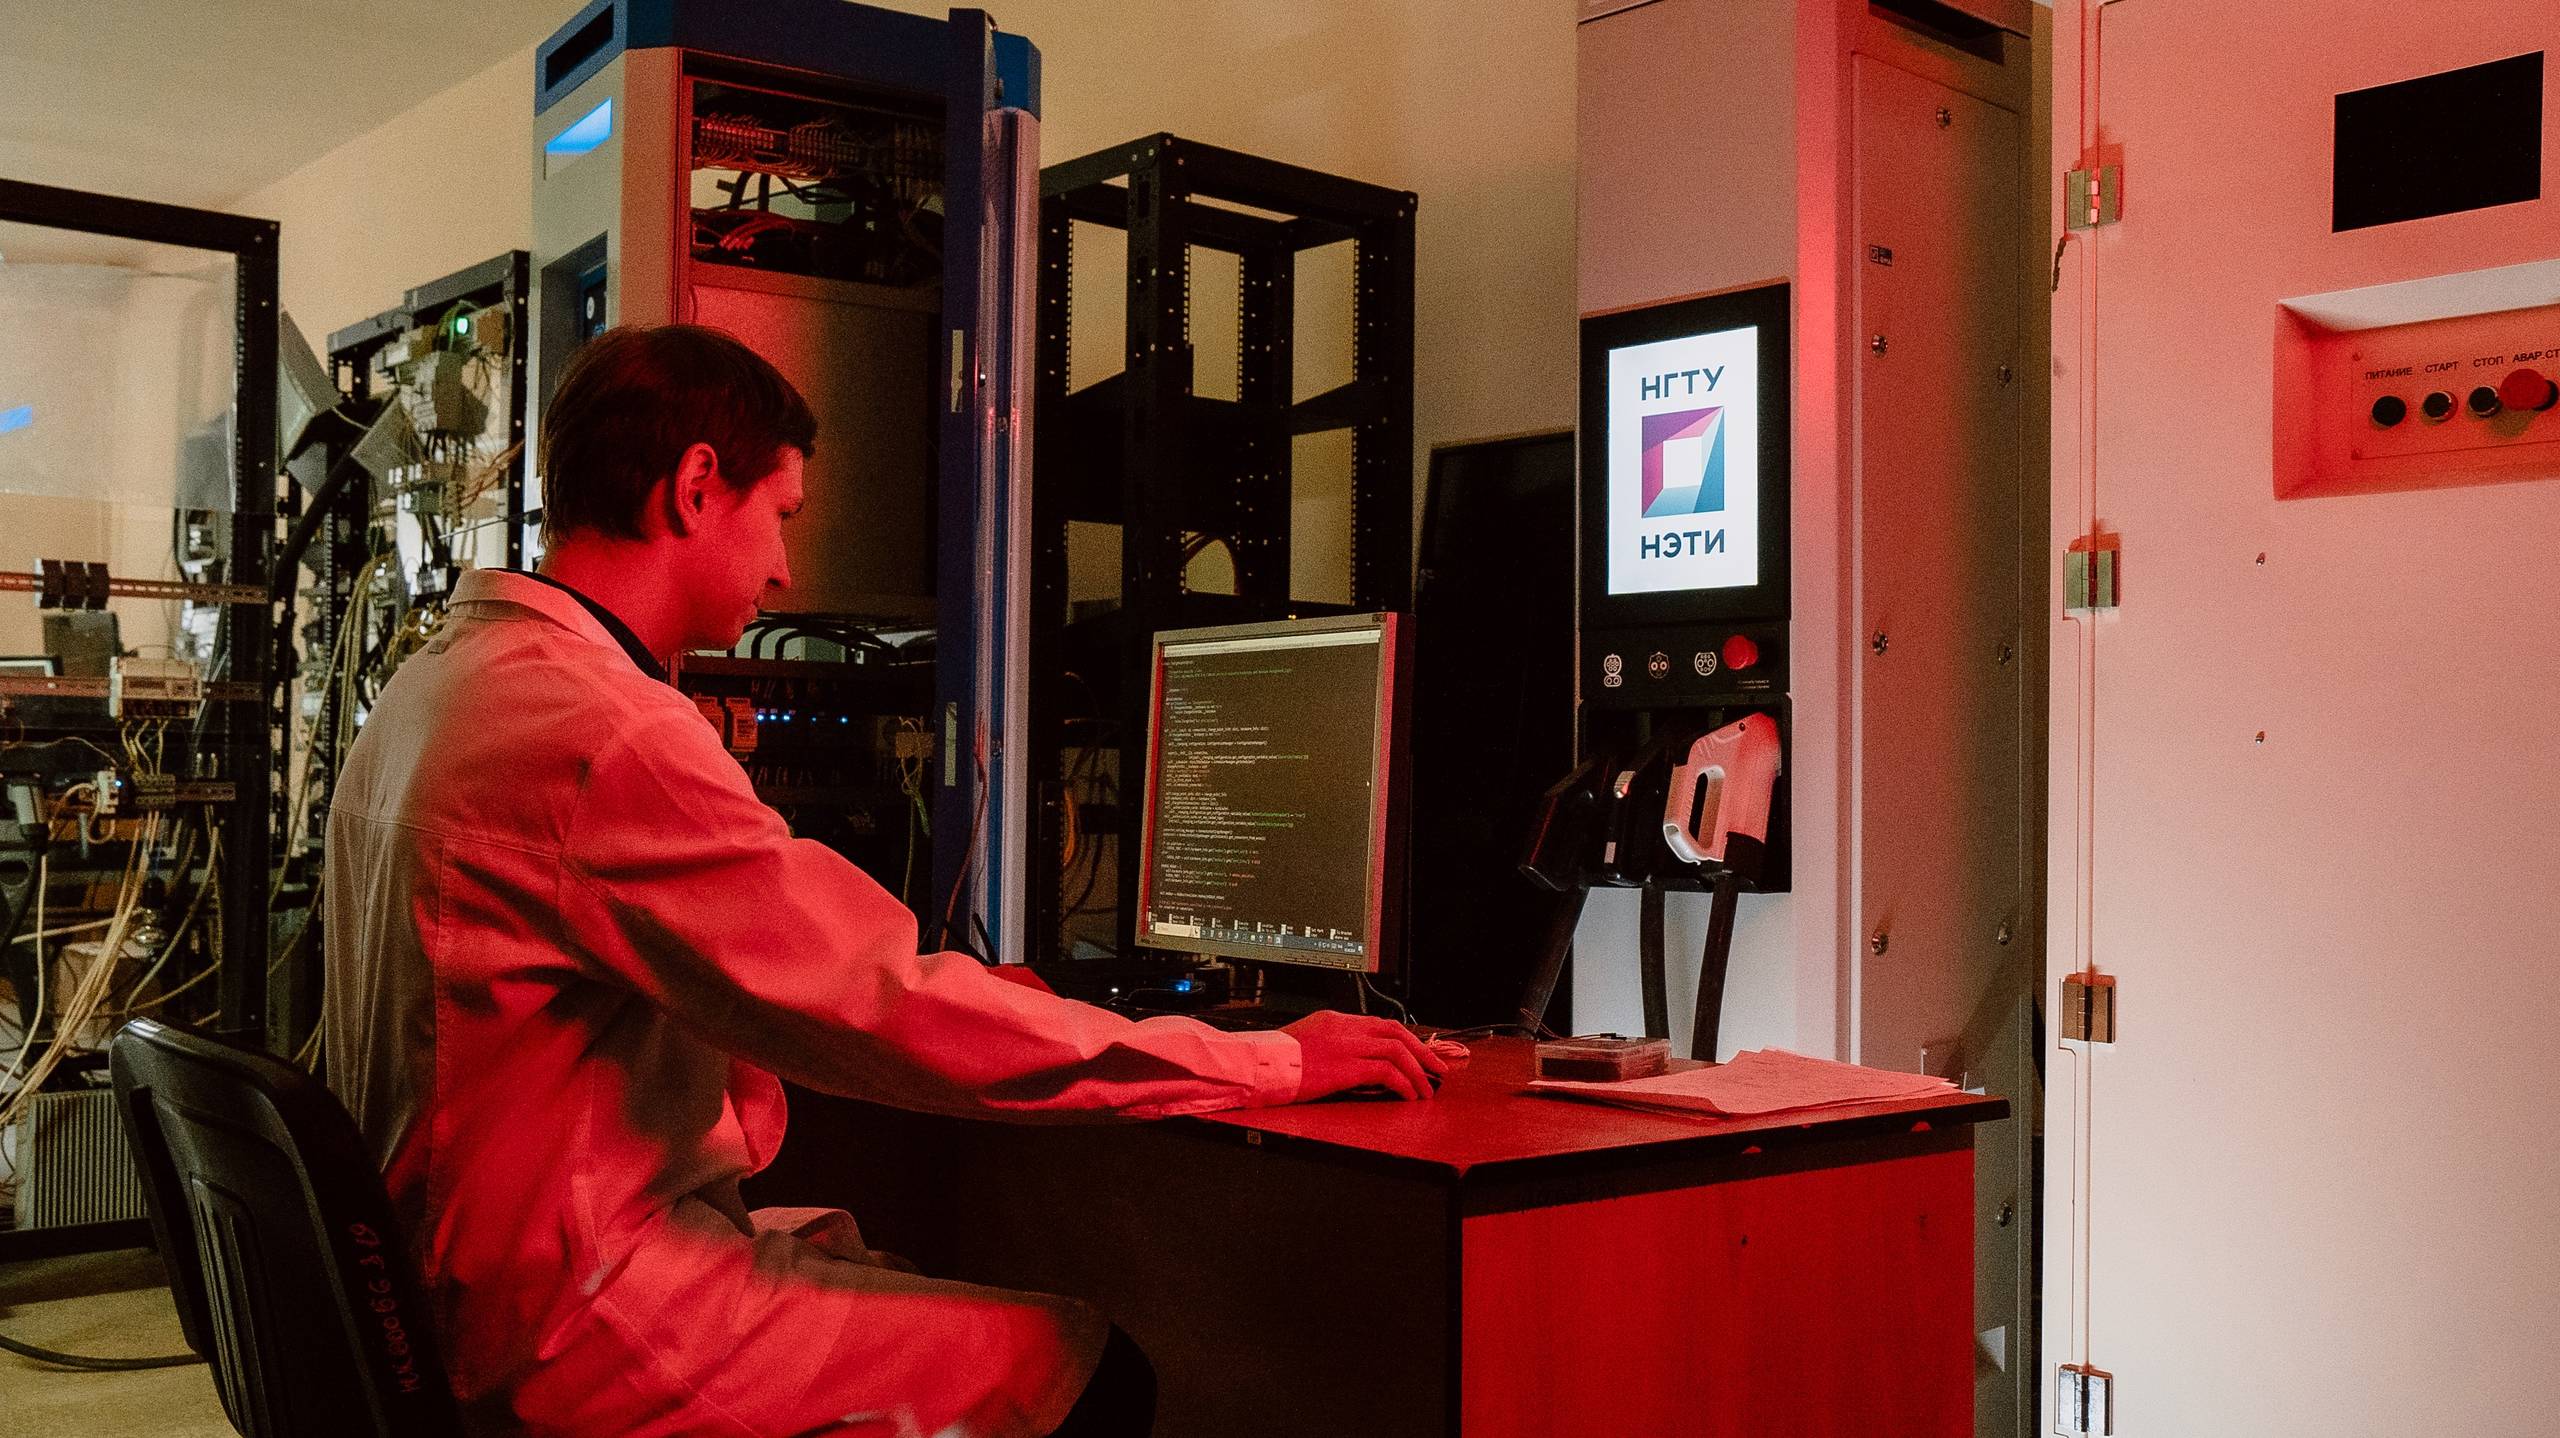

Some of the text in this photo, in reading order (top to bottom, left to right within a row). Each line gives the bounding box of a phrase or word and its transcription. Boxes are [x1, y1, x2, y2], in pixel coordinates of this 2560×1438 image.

[2424, 361, 2459, 373] СТАРТ
[2473, 356, 2504, 367] СТОП
[2364, 367, 2413, 380] ПИТАНИЕ
[1641, 365, 1725, 401] НГТУ
[1641, 528, 1725, 559] НЭТИ
